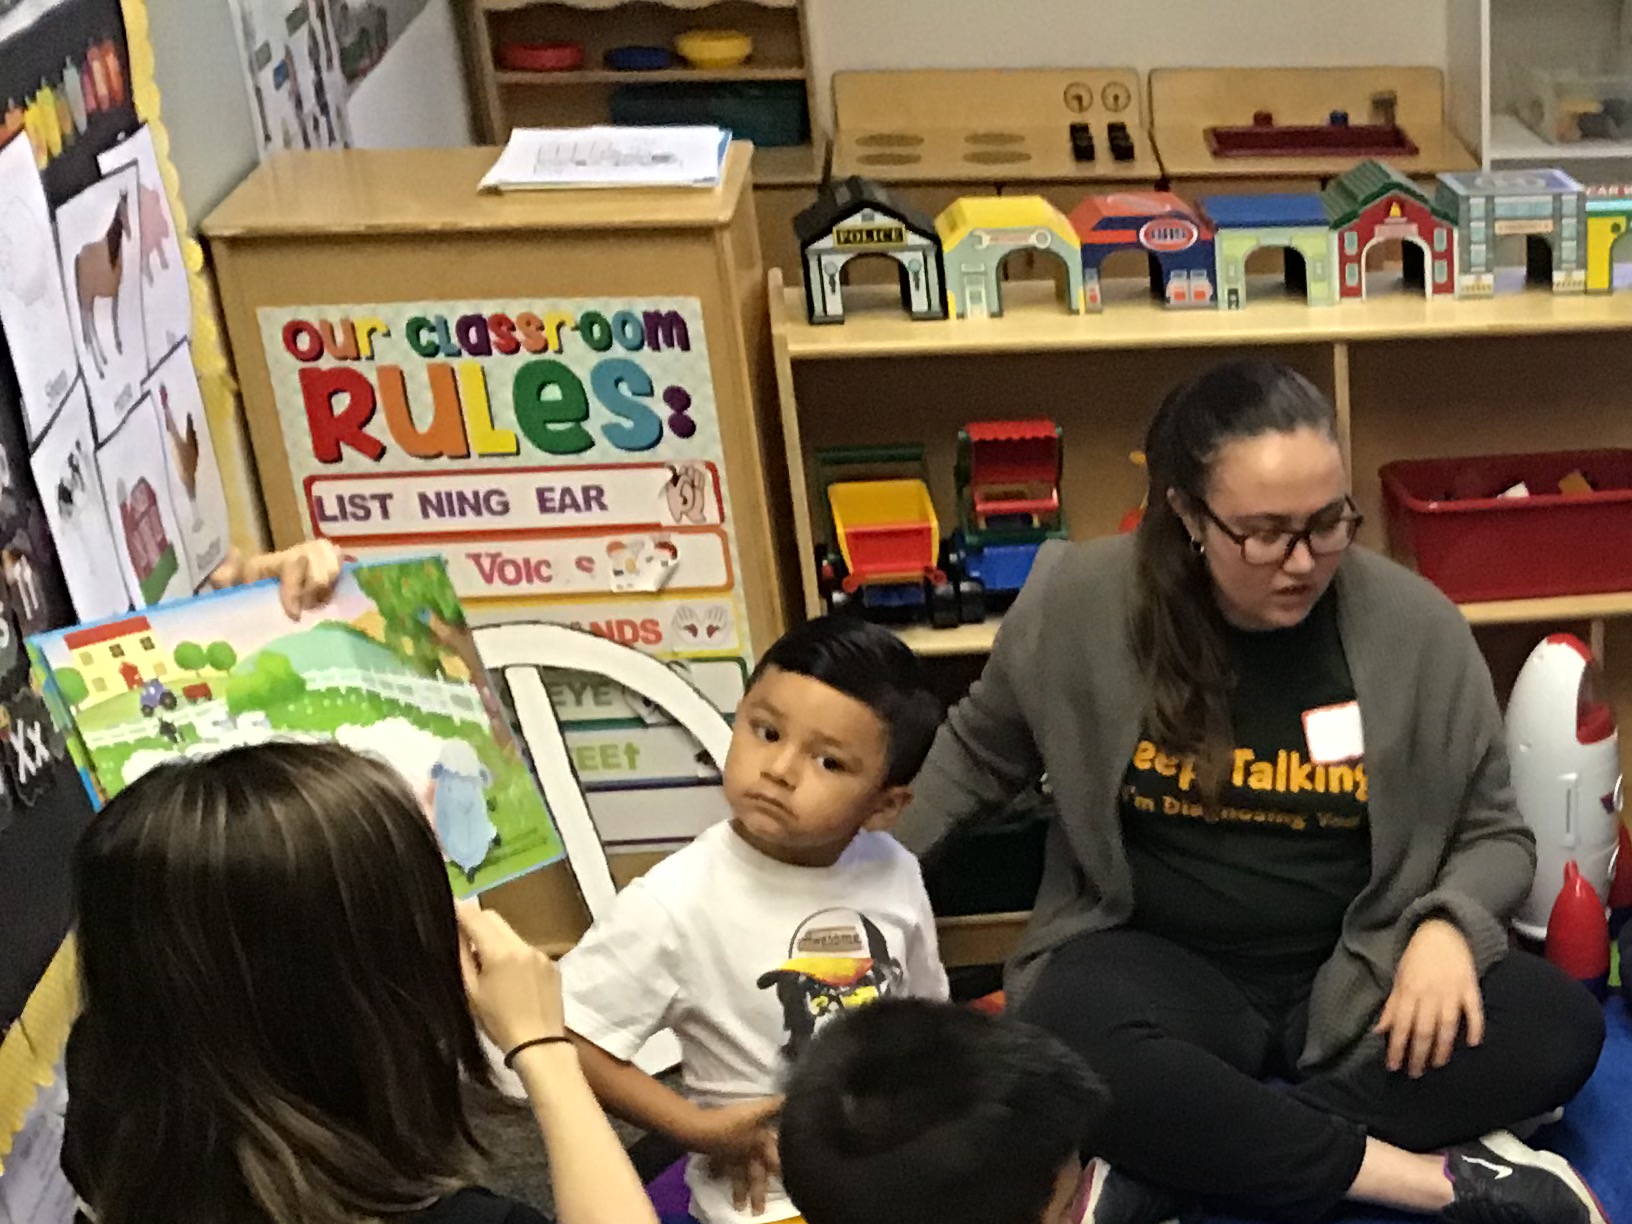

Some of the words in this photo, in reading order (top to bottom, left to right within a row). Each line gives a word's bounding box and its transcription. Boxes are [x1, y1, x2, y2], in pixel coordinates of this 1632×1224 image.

[839, 227, 901, 244] POLICE
[314, 492, 394, 523] LIST
[416, 489, 510, 520] NING
[535, 484, 609, 514] EAR
[1133, 739, 1197, 791] eep
[1231, 748, 1369, 802] Talking
